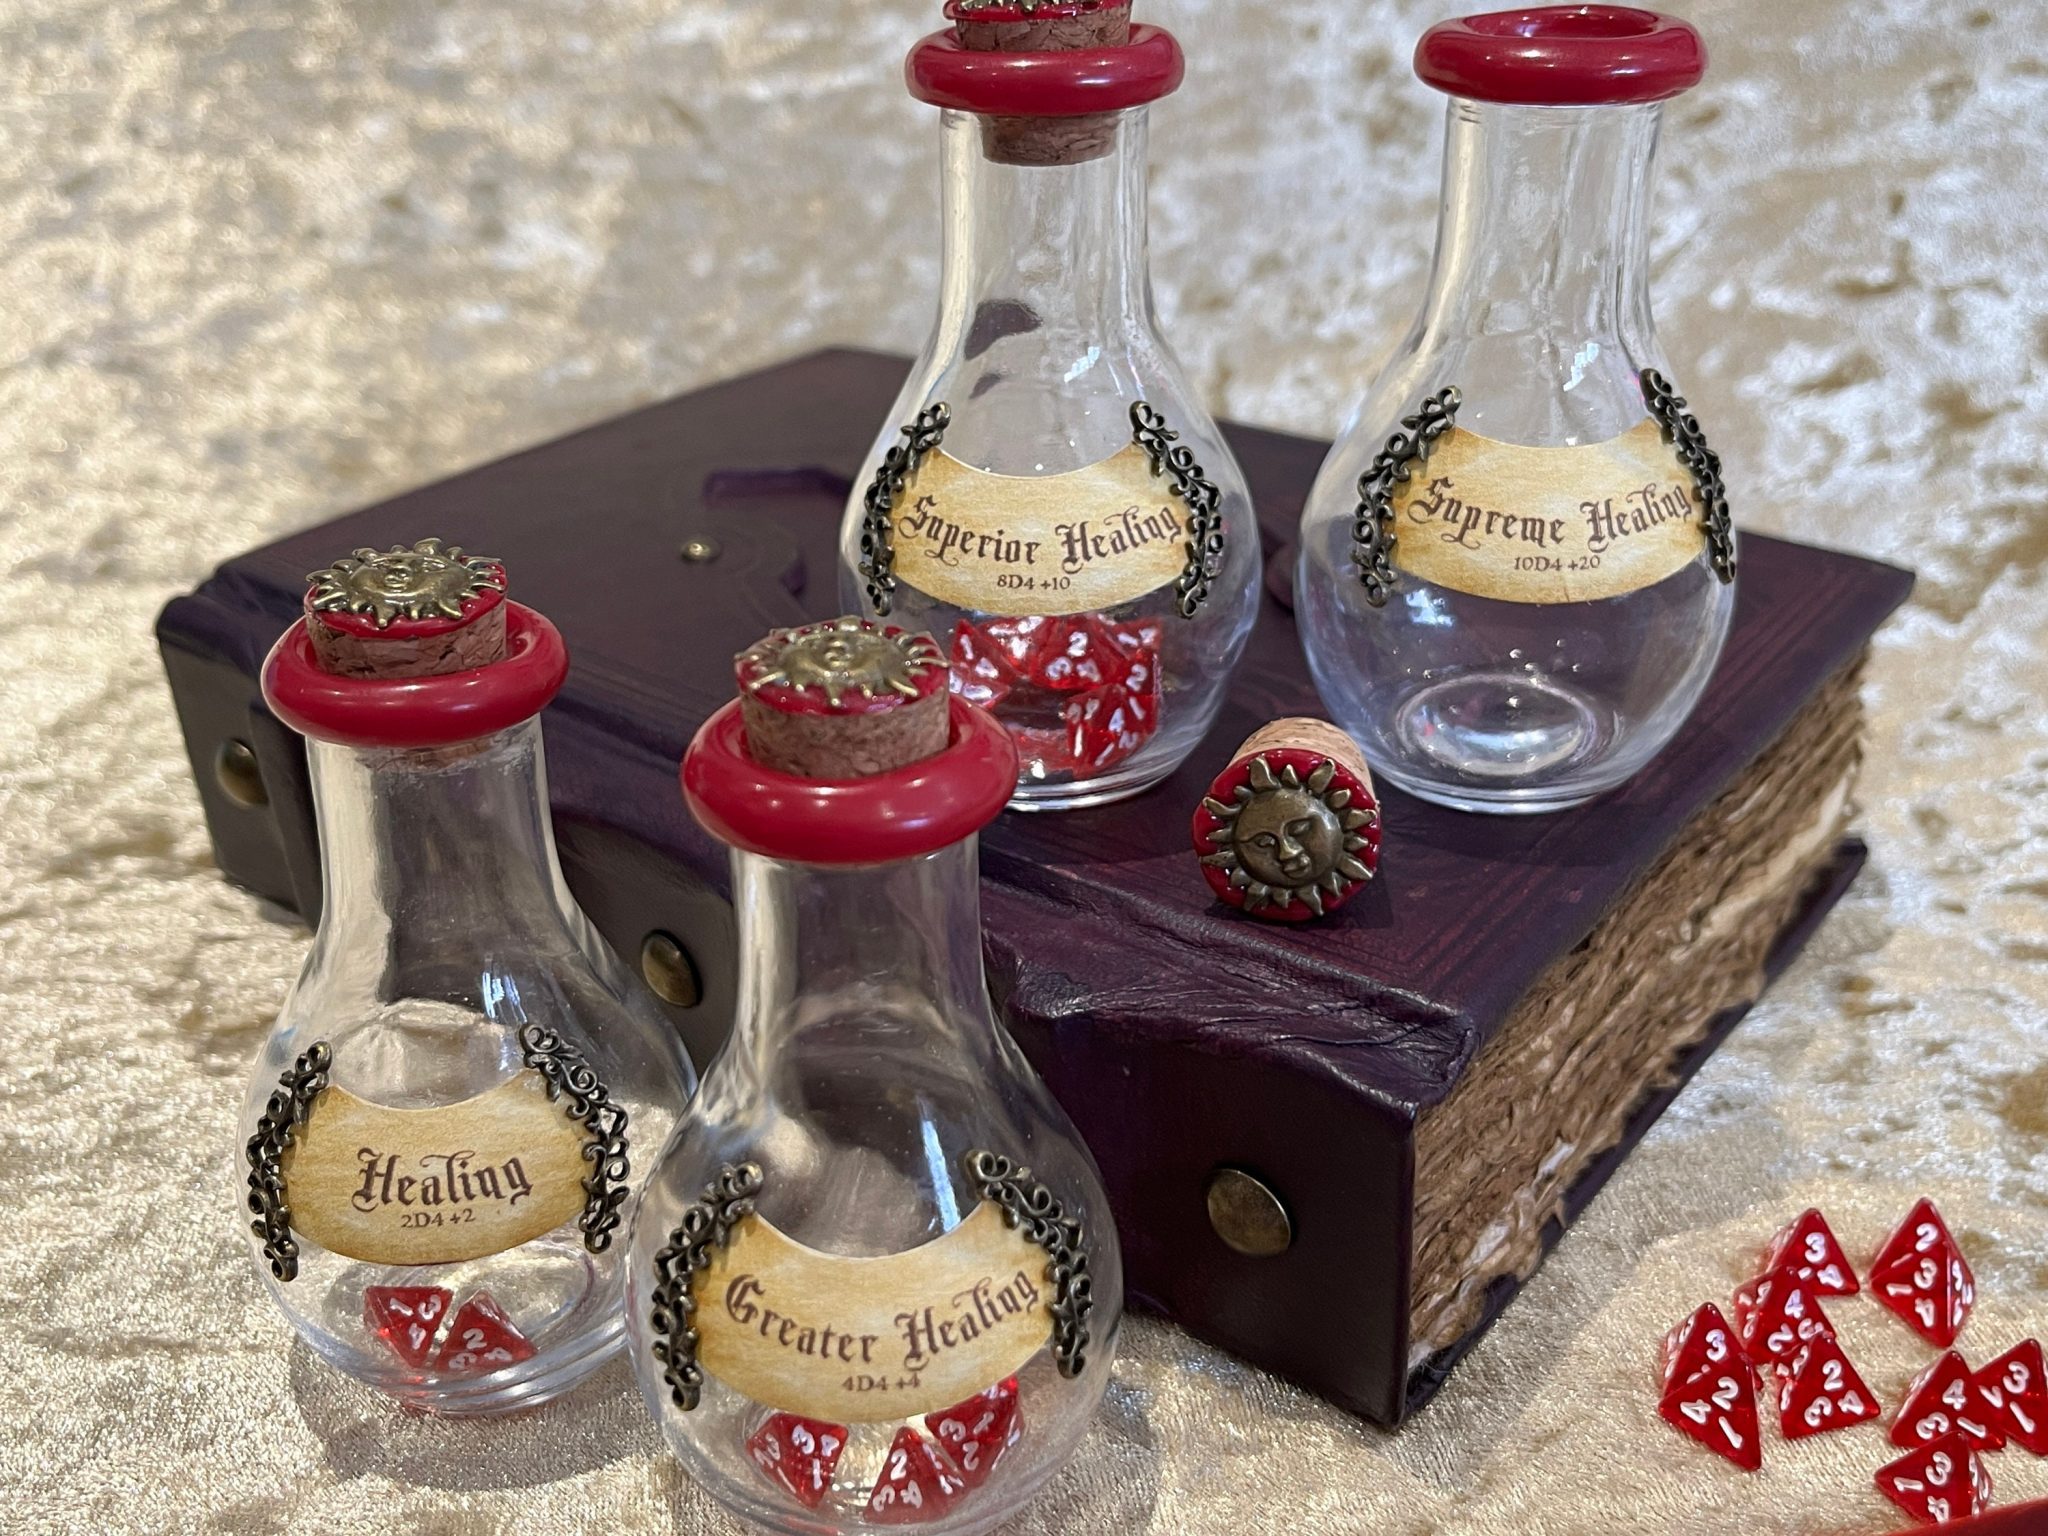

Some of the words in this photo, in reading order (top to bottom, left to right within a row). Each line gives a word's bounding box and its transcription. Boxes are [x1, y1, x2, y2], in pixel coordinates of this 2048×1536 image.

[1407, 476, 1565, 550] Supreme
[1579, 482, 1693, 553] Healing
[899, 494, 1041, 567] Superior
[1055, 505, 1183, 575] Healing
[351, 1147, 534, 1213] Healing
[1805, 1232, 1826, 1263] 3
[1915, 1222, 1938, 1252] 2
[1817, 1264, 1844, 1289] 4
[1914, 1257, 1937, 1289] 3
[1784, 1289, 1804, 1319] 4
[1915, 1297, 1935, 1328] 4
[725, 1274, 879, 1364] Greater
[894, 1270, 1039, 1371] Healing
[462, 1328, 488, 1350] 2
[1706, 1328, 1727, 1361] 3
[1768, 1323, 1793, 1351] 2
[1822, 1359, 1844, 1391] 2
[2002, 1361, 2030, 1394] 3
[1711, 1376, 1739, 1411] 2
[1837, 1390, 1864, 1415] 4
[1942, 1378, 1967, 1411] 4
[1680, 1399, 1711, 1425] 4
[1804, 1396, 1832, 1427] 3
[1915, 1411, 1950, 1440] 3
[890, 1448, 908, 1481] 2
[1925, 1451, 1952, 1486] 3
